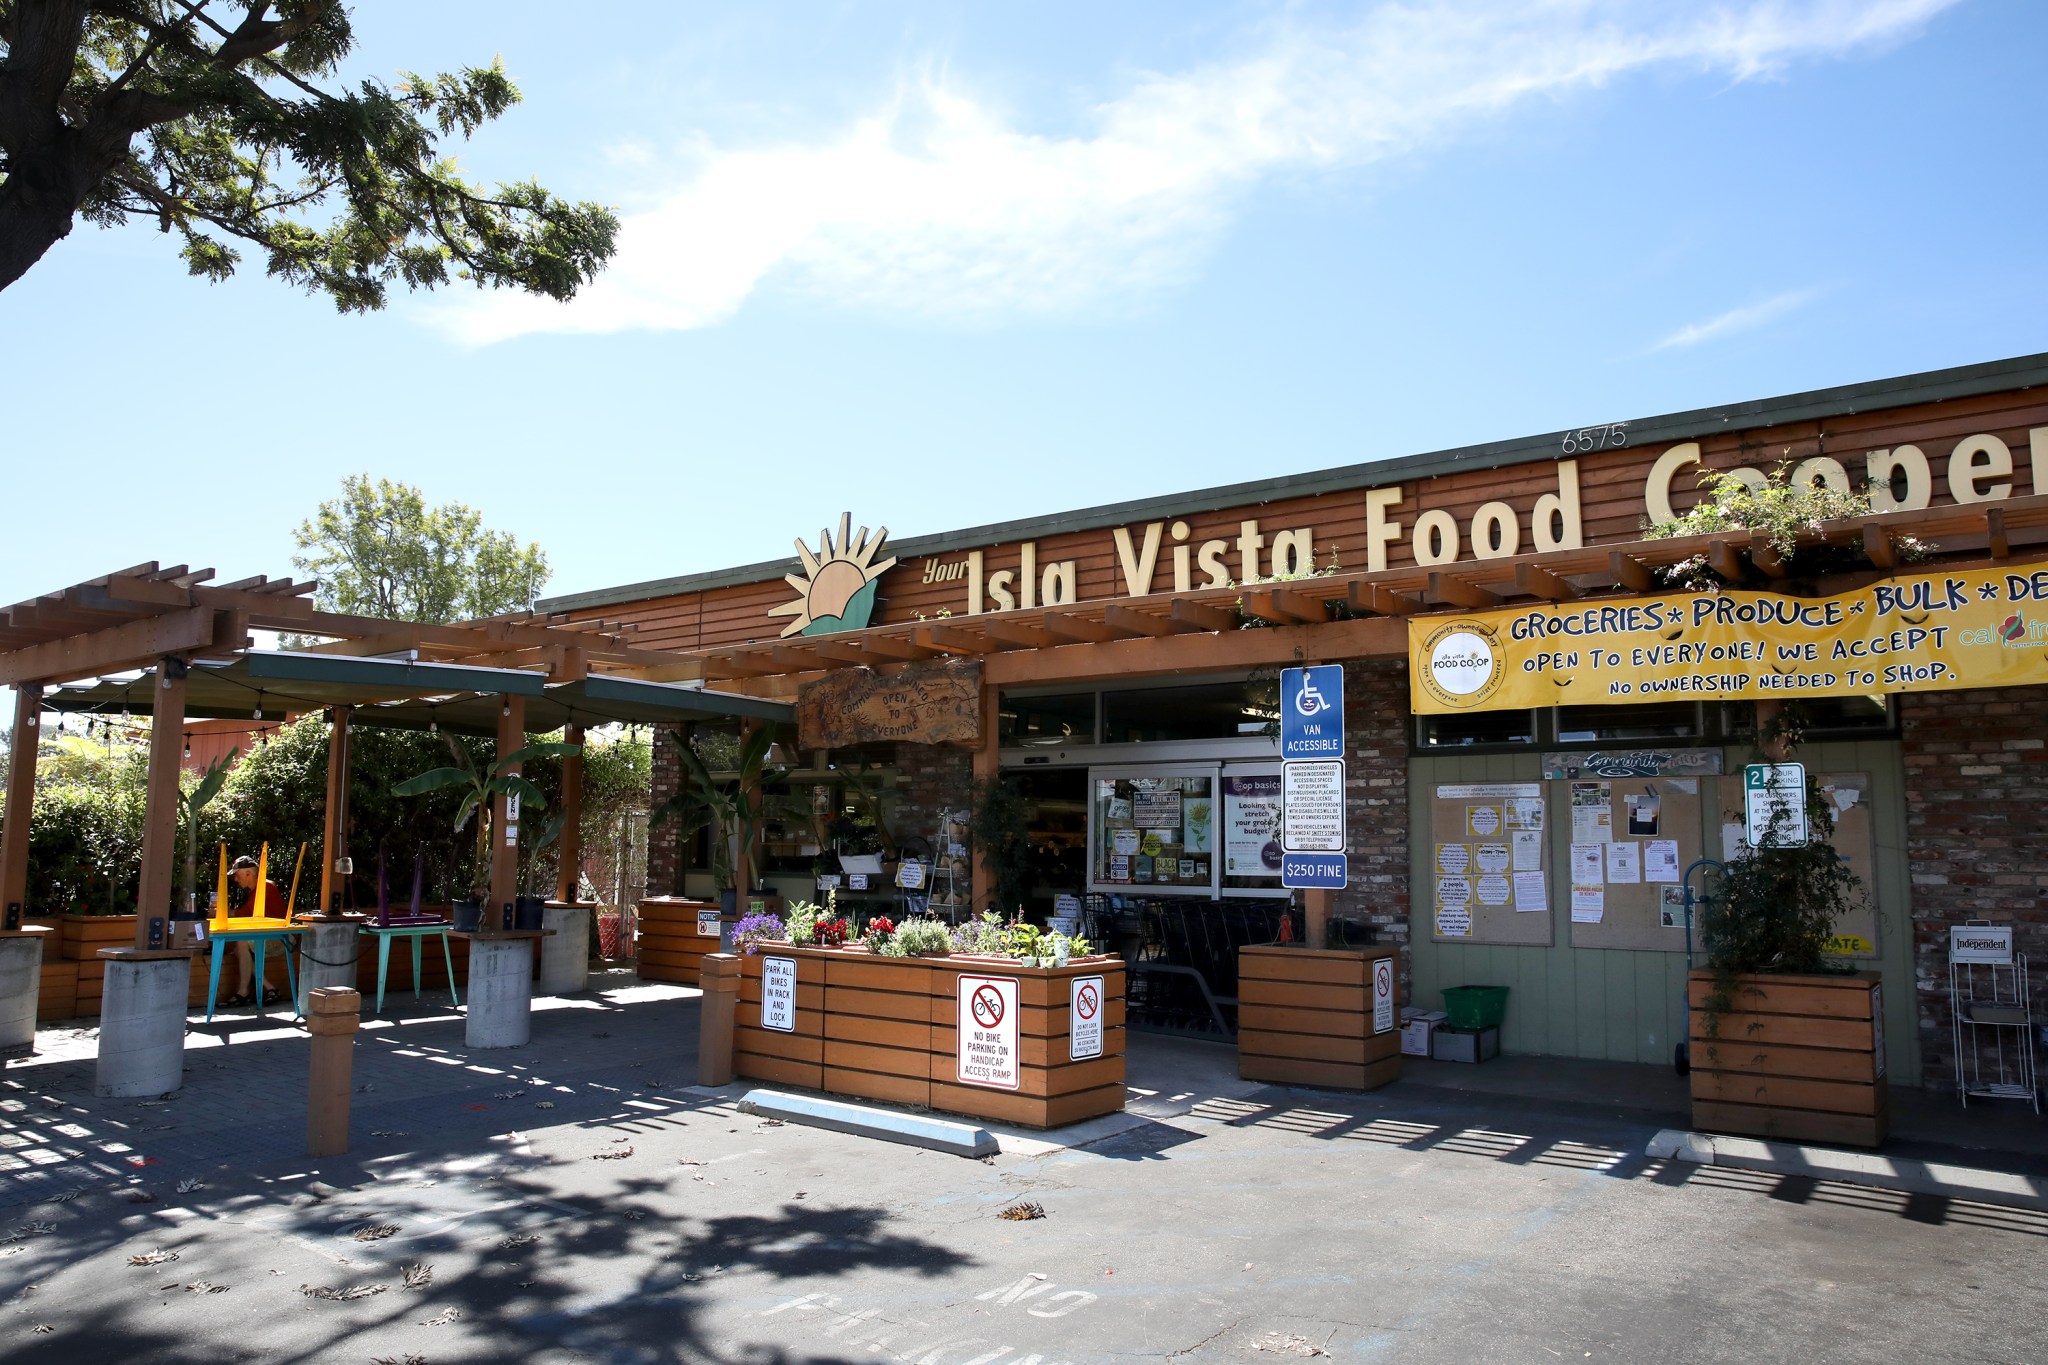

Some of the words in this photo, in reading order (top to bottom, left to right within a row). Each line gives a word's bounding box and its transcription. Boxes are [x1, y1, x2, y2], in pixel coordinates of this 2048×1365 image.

[1561, 422, 1627, 454] 6575
[922, 558, 969, 585] Your
[968, 542, 1077, 616] Isla
[1113, 520, 1313, 597] Vista
[1366, 459, 1583, 572] Food
[1645, 427, 2048, 527] Cope
[1873, 578, 1969, 617] BULK
[1958, 623, 1997, 646] cal
[1522, 651, 1579, 673] OPEN
[1589, 649, 1621, 669] TO
[1632, 641, 1766, 667] EVERYONE!
[1777, 643, 1819, 662] WE
[1831, 626, 1949, 660] ACCEPT
[1433, 660, 1458, 669] FOOD
[1609, 680, 1632, 696] NO
[1639, 673, 1750, 694] OWNERSHIP
[1758, 672, 1837, 690] NEEDED
[1845, 669, 1876, 687] TO
[1883, 662, 1957, 685] SHOP.
[841, 678, 890, 716] COMMUNITY
[882, 694, 908, 706] OPEN
[888, 709, 900, 719] TO
[871, 720, 919, 737] EVERYONE
[1303, 724, 1321, 736] VAN
[1287, 739, 1339, 752] ACCESSIBLE
[1584, 751, 1671, 777] Community
[1751, 771, 1760, 785] 2
[1235, 820, 1251, 828] your
[1287, 862, 1315, 878] $250
[1317, 864, 1342, 877] FINE
[700, 913, 719, 921] NOTIC
[1957, 938, 2007, 950] Independent
[766, 964, 781, 974] PARK
[782, 966, 793, 976] ALL
[770, 977, 788, 987] BIKES
[767, 988, 774, 997] IN
[774, 988, 791, 999] RACK
[772, 1000, 785, 1010] AND
[770, 1012, 786, 1022] LOCK
[974, 1031, 984, 1041] NO
[985, 1032, 1001, 1043] BIKE
[967, 1042, 996, 1055] PARKING
[998, 1046, 1008, 1056] ON
[971, 1054, 1005, 1067] HANDICAP
[965, 1066, 990, 1077] ACCESS
[992, 1069, 1011, 1080] RAMP
